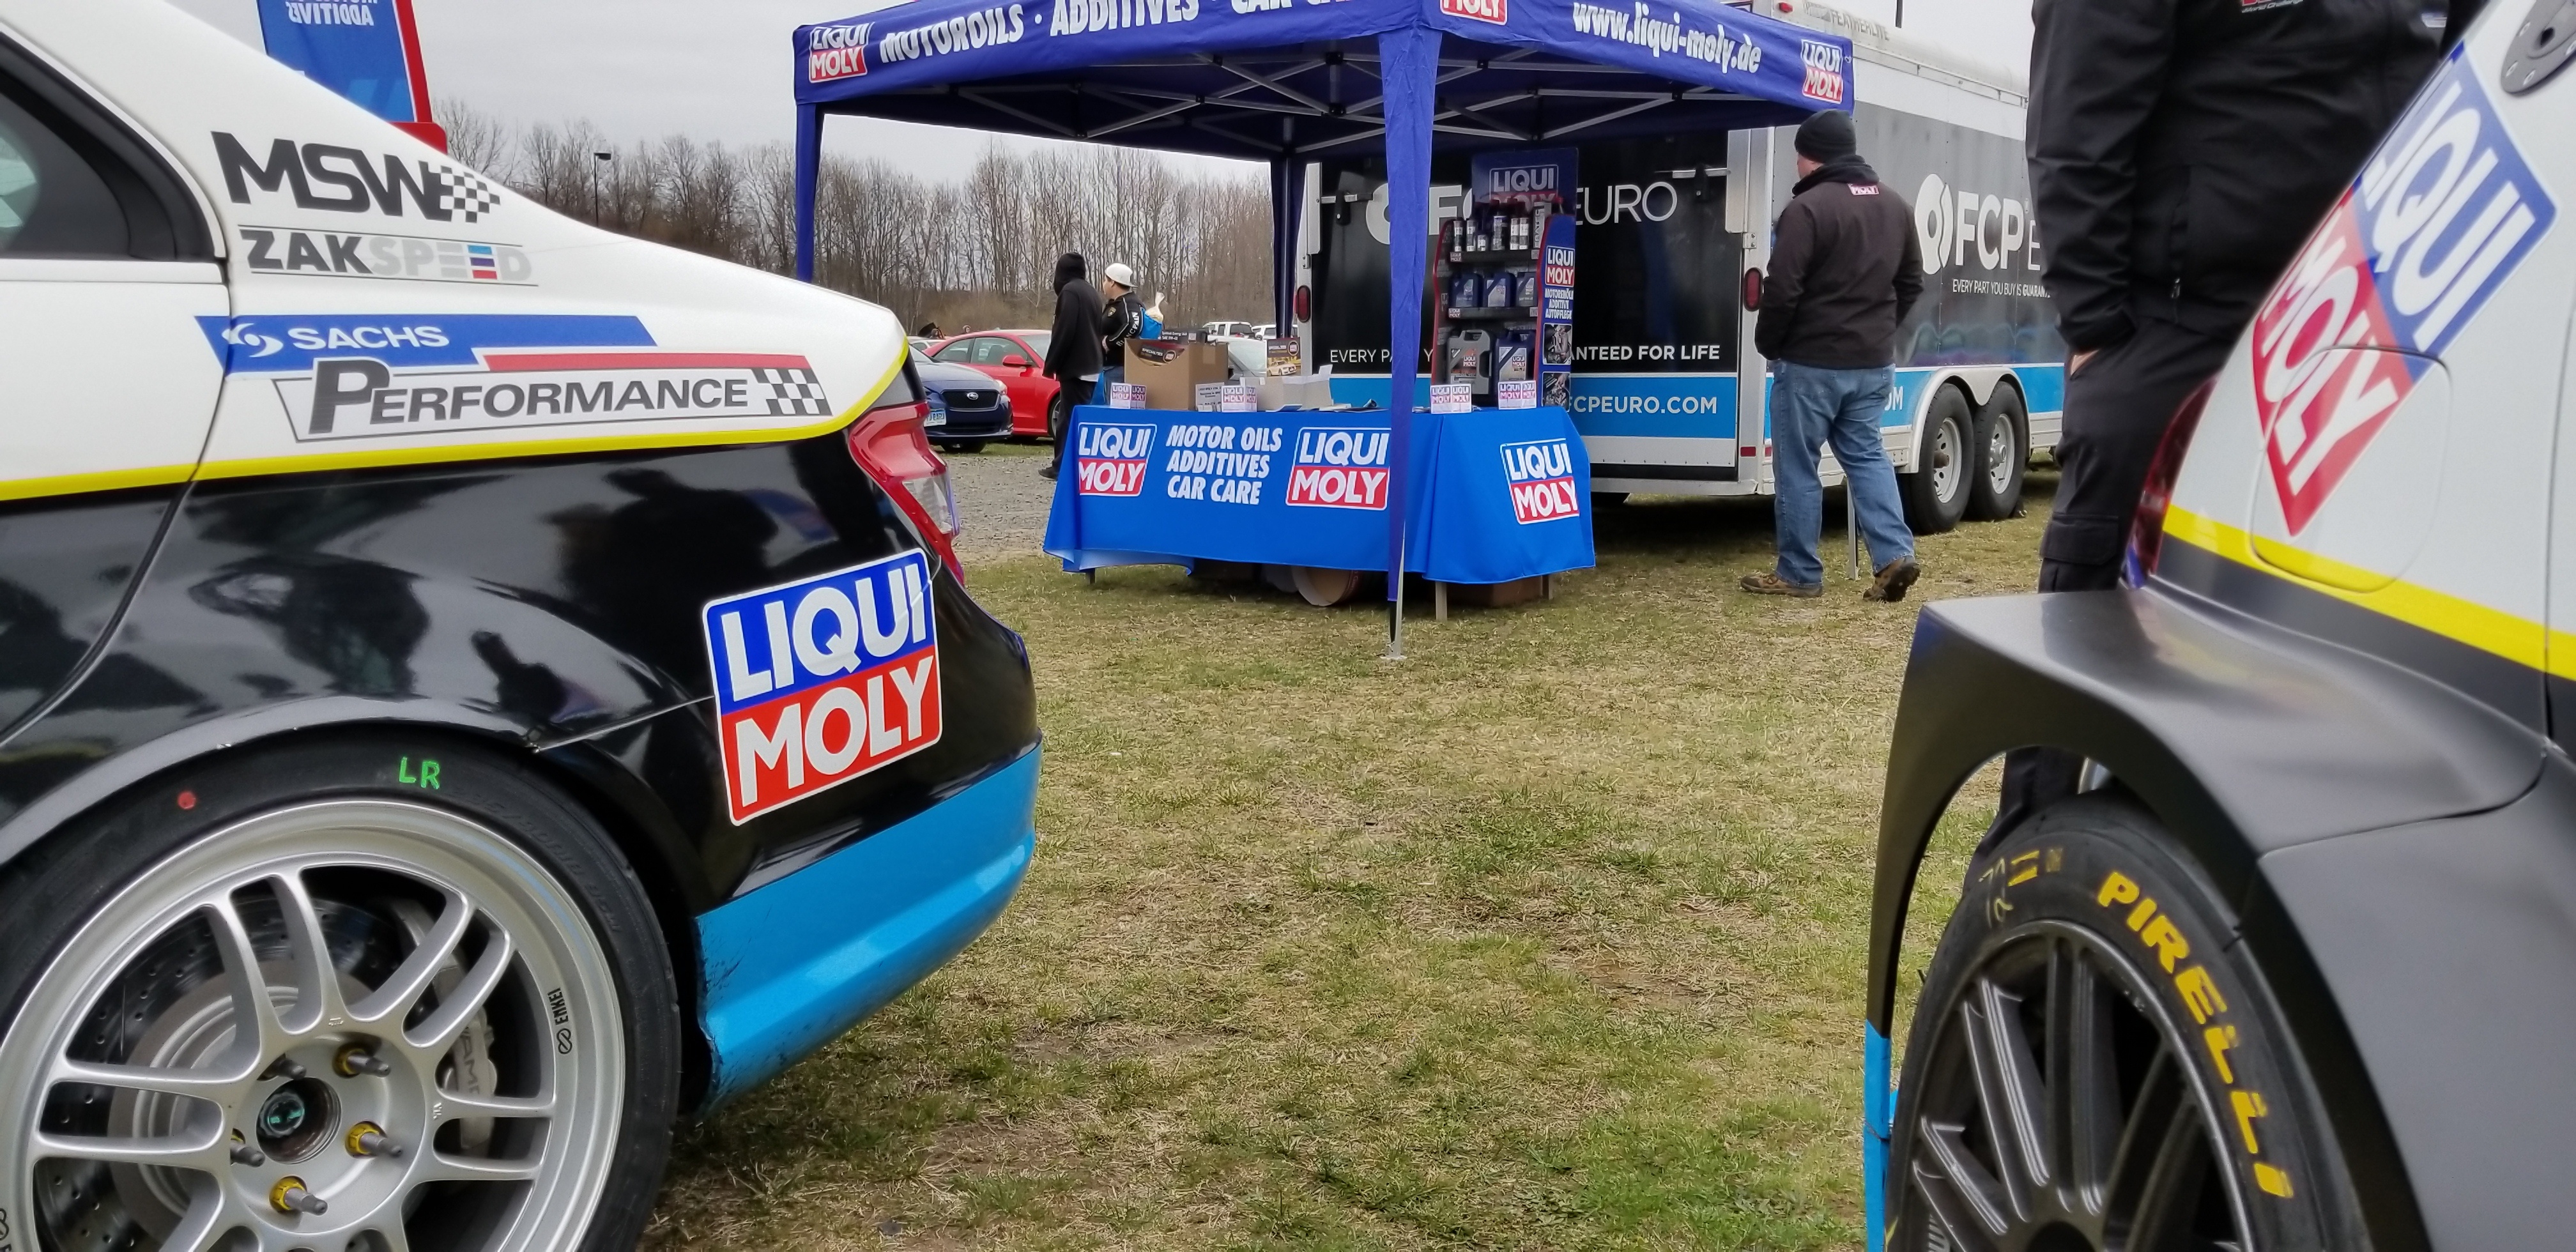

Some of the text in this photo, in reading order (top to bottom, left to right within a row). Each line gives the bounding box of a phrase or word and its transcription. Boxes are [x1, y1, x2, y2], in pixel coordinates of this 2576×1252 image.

[813, 23, 870, 50] LIQUI
[879, 4, 1023, 63] MOTOROILS
[1572, 1, 1761, 73] www.liqui-moly.de
[811, 46, 862, 79] MOLY
[1804, 42, 1843, 72] LIQUI
[1805, 68, 1843, 100] MOLY
[211, 131, 452, 222] MSW
[1494, 168, 1554, 192] LIQUI
[2361, 57, 2536, 353] LIQUI
[1956, 191, 2024, 270] FCP
[240, 229, 532, 282] ZAKSPEED
[1547, 248, 1574, 267] LIQUI
[1546, 266, 1574, 285] MOLY
[1952, 279, 1973, 293] EVERY
[1974, 280, 1989, 294] PART
[1991, 281, 2004, 295] YOU
[2004, 282, 2016, 296] BUY
[288, 326, 450, 350] SACHS
[1330, 349, 1377, 363] EVERY
[1638, 345, 1675, 360] FOR
[1681, 345, 1721, 360] LIFE
[2260, 206, 2400, 497] MOLY
[308, 360, 749, 434] PERFORMANCE
[1079, 424, 1149, 459] LIQUI
[1166, 425, 1283, 453] MOTOR OILS
[1298, 434, 1388, 468] LIQUI
[1078, 461, 1144, 494] MOLY
[1165, 450, 1271, 478] ADDITIVES
[1505, 442, 1572, 482] LIQUI
[1167, 475, 1262, 505] CAR CARE
[1291, 468, 1388, 505] MOLY
[1514, 478, 1577, 519] MOLY
[721, 563, 927, 703] LIQUI
[735, 654, 934, 807] MOLY
[398, 756, 441, 790] LR
[547, 987, 569, 1026] ENKEI
[2097, 871, 2294, 1200] PIRELLI
